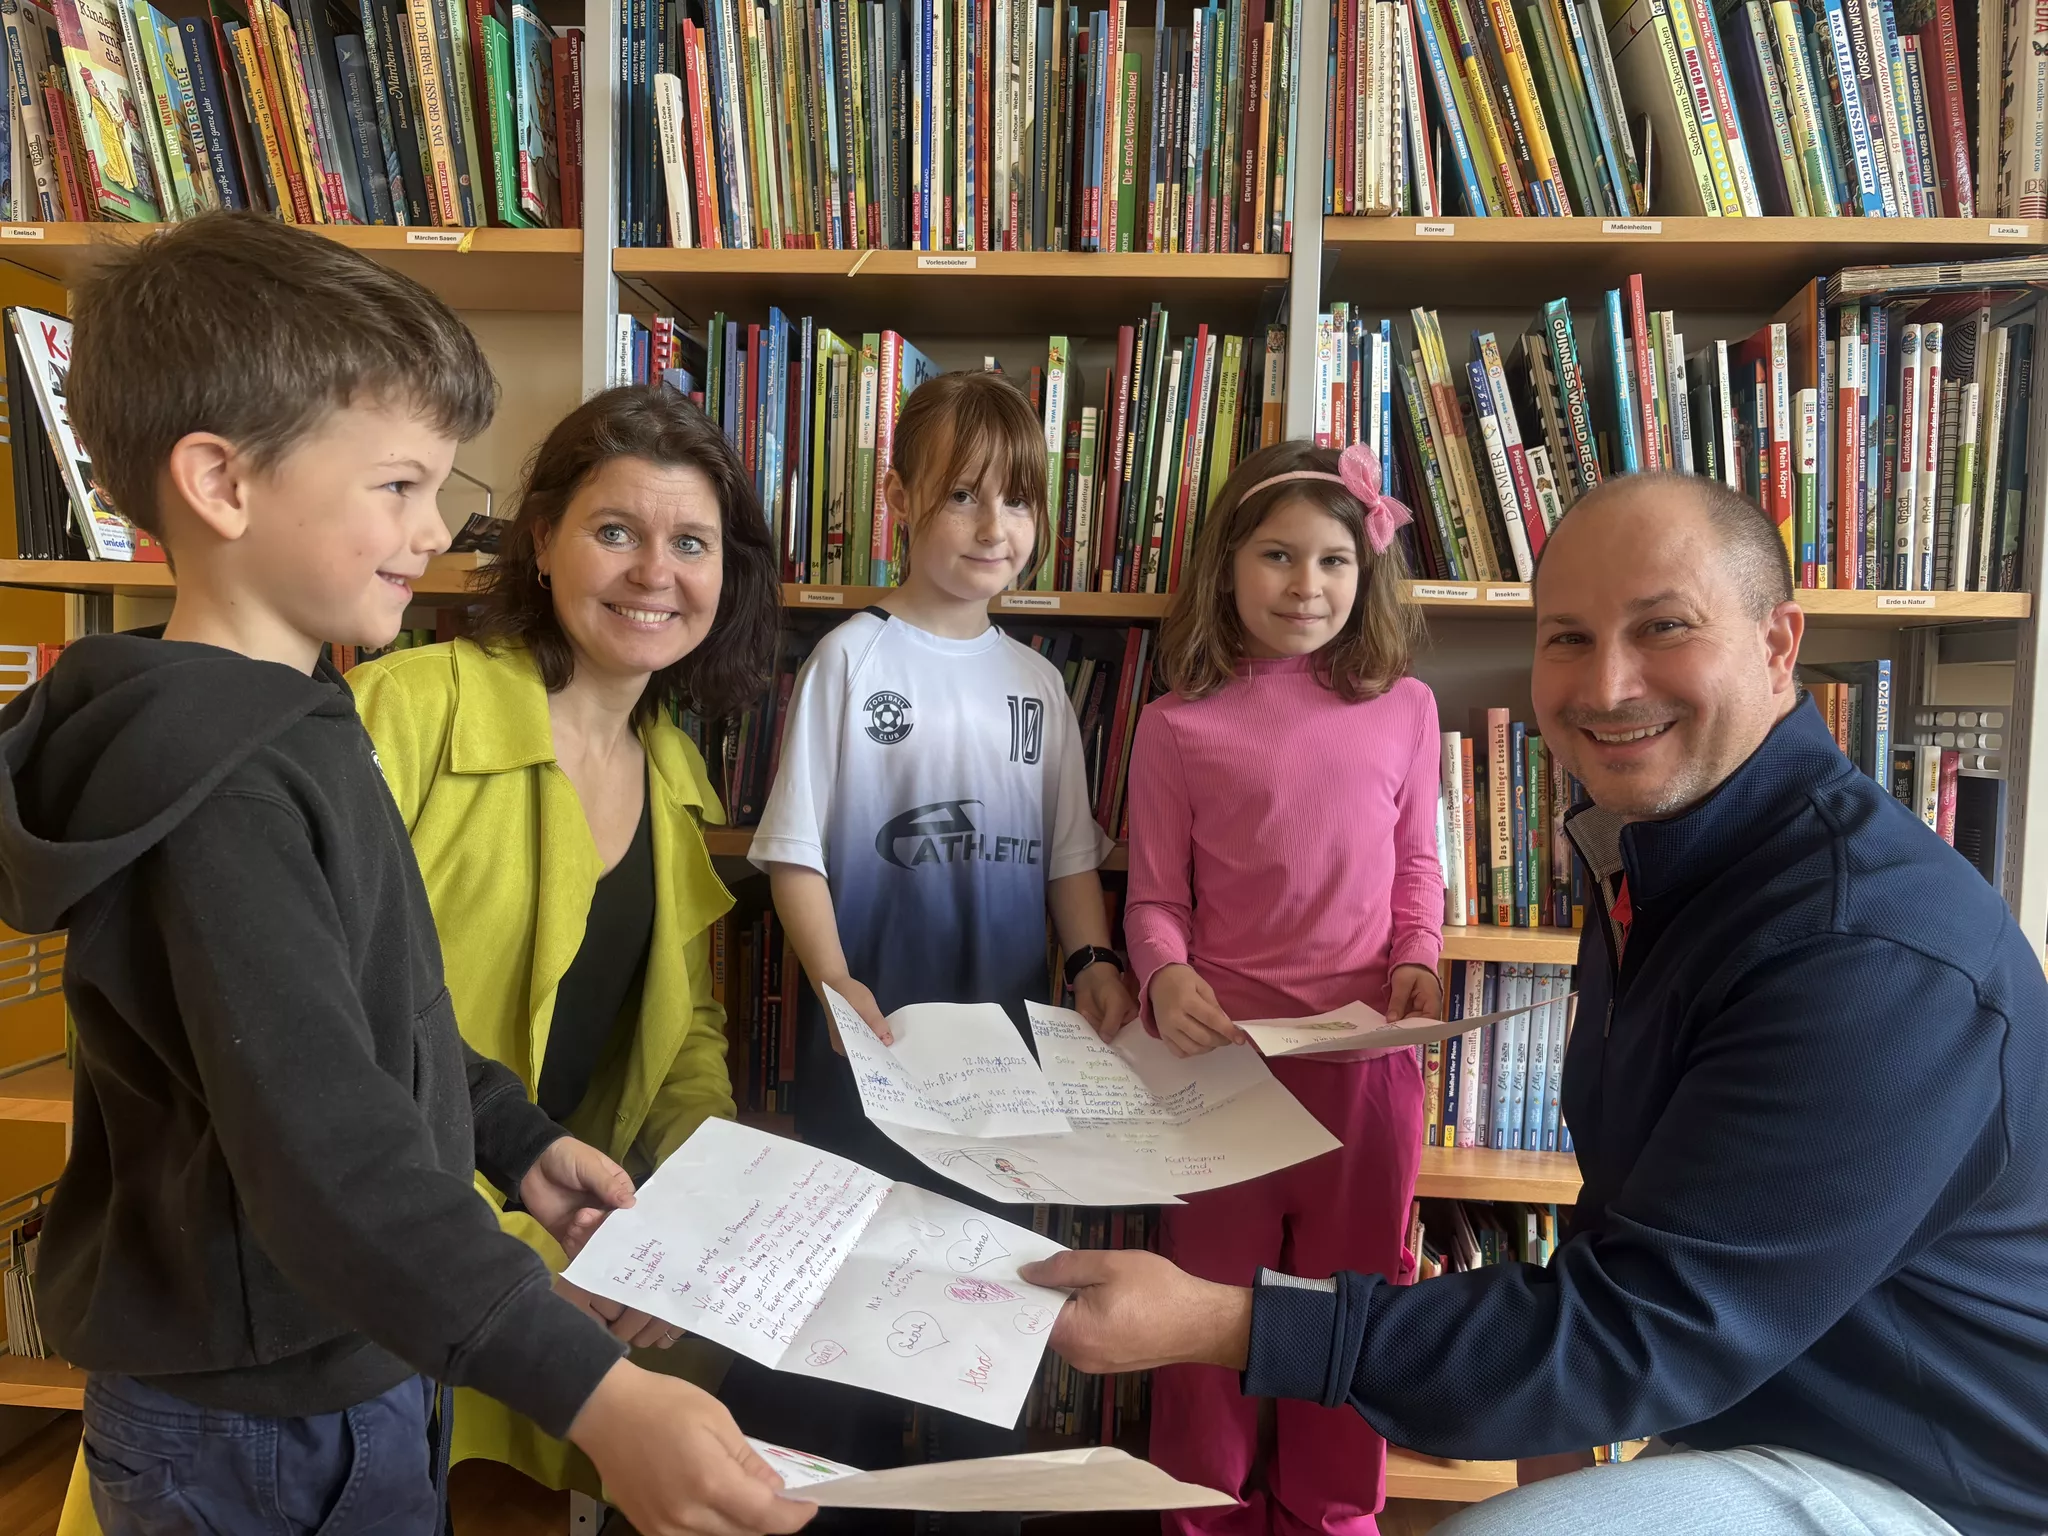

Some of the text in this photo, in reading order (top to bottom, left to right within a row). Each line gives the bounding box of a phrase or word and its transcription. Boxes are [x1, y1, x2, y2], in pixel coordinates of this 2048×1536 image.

[1430, 7, 1442, 30] Mensch
[1452, 9, 1467, 42] Abenteuer
[1494, 5, 1511, 48] Unser Essen
[9, 33, 22, 61] Englisch
[105, 47, 121, 67] die
[569, 37, 577, 53] Katz
[1508, 14, 1528, 71] Ich weiß was vom
[1706, 40, 1716, 59] was
[1940, 5, 1957, 91] BILDERLEXIKON
[384, 50, 402, 99] Märchen
[414, 11, 443, 147] DAS GROSSE FABELBUCH
[570, 56, 578, 69] und
[1685, 49, 1702, 85] MACH
[1711, 61, 1721, 76] ich
[373, 79, 384, 103] Meine
[571, 70, 579, 92] Hund
[1249, 79, 1257, 98] große
[1660, 25, 1702, 156] Sachen zum Selbermachen
[1715, 78, 1730, 111] wissen
[1755, 30, 1793, 160] Können Schiffe Treppen steigen?
[1784, 33, 1816, 147] Warum wackelt Wackelpudding?
[2036, 77, 2045, 111] Lexikon
[157, 93, 172, 126] NATURE
[177, 66, 205, 154] KINDERSPIELE
[201, 96, 214, 115] Jahr
[572, 93, 580, 109] Wie
[1831, 13, 1872, 188] DAS ALLESWISSER BUCH
[207, 114, 220, 136] ganze
[255, 88, 278, 158] WUT weg Buch
[844, 97, 853, 173] MORGENSTERN
[1122, 71, 1138, 184] Die große Wippschaukel
[1502, 84, 1529, 161] Alles was ich wissen will
[1724, 111, 1734, 129] will
[1907, 54, 1932, 184] Alles was wissen will
[2034, 121, 2043, 146] 10.000
[165, 127, 179, 155] HAPPY
[210, 137, 222, 151] fürs
[213, 153, 224, 172] Buch
[2033, 149, 2041, 172] Fotos
[218, 173, 232, 195] große
[439, 169, 452, 218] ANNETTE BETZ
[1610, 223, 1652, 231] Maßeinheiten
[925, 258, 968, 266] Vorlesebücher
[619, 342, 627, 366] lustigen
[1552, 318, 1577, 388] GUINNESS
[1567, 390, 1588, 442] WORLD
[1826, 372, 1834, 392] Erde
[1930, 375, 1938, 412] Bauernhof
[1166, 385, 1175, 422] Regenwald
[1679, 393, 1688, 439] Dinosaurier
[1902, 376, 1912, 462] Entdecke den Bauernhof
[872, 339, 891, 546] MiniMaxiWissen Pferde und Ponys
[1116, 415, 1125, 441] Spuren
[1928, 428, 1936, 462] Entdecke
[1490, 450, 1518, 521] DAS MEER
[1512, 449, 1523, 474] Pferde
[1520, 487, 1532, 511] Ponys
[1777, 470, 1787, 498] Körper
[103, 539, 125, 548] unicef
[868, 695, 905, 710] FOOTBALL
[1876, 680, 1889, 732] OZEANE
[878, 732, 900, 741] CLUB
[1006, 695, 1044, 765] 10
[1494, 723, 1504, 763] Lesebuch
[1496, 766, 1507, 812] Nöstlinger
[1498, 845, 1507, 860] Das
[1184, 1162, 1208, 1170] und
